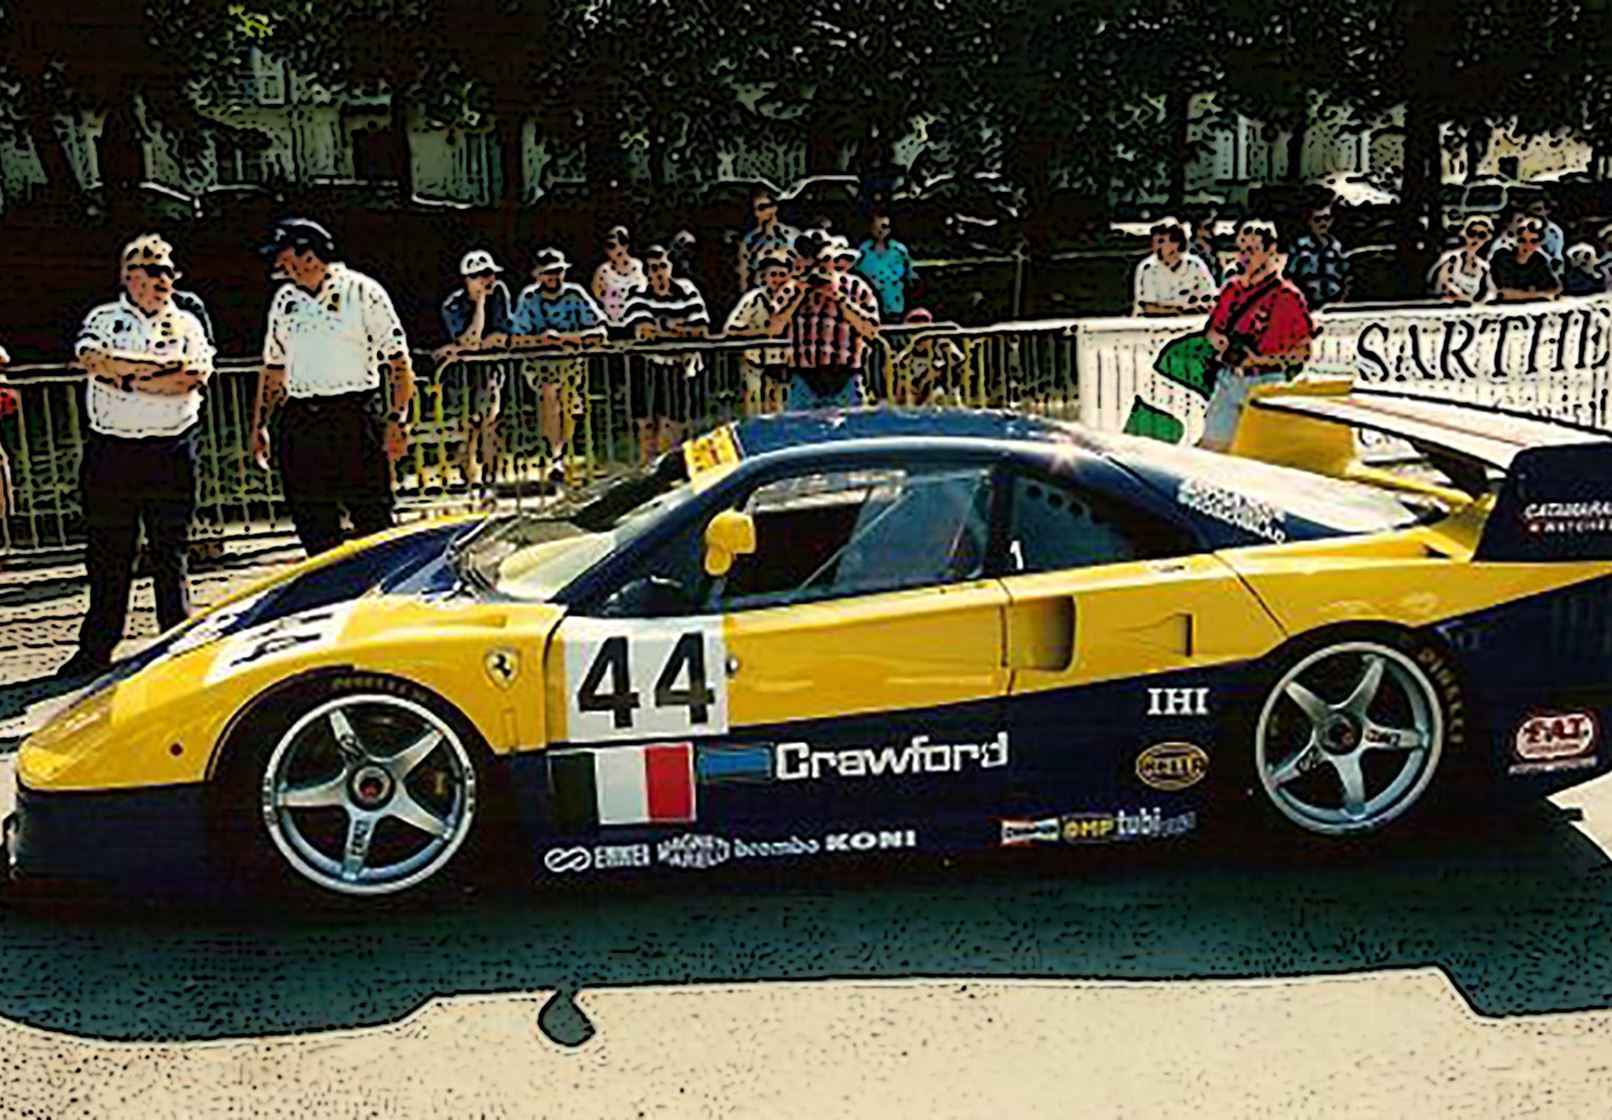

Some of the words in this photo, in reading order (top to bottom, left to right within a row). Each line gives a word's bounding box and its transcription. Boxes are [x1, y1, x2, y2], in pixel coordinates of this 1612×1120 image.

[1357, 308, 1611, 383] SARTHE
[577, 632, 715, 729] 44
[1147, 687, 1210, 716] IHI
[776, 732, 1009, 781] Crawford
[825, 830, 916, 851] KONI
